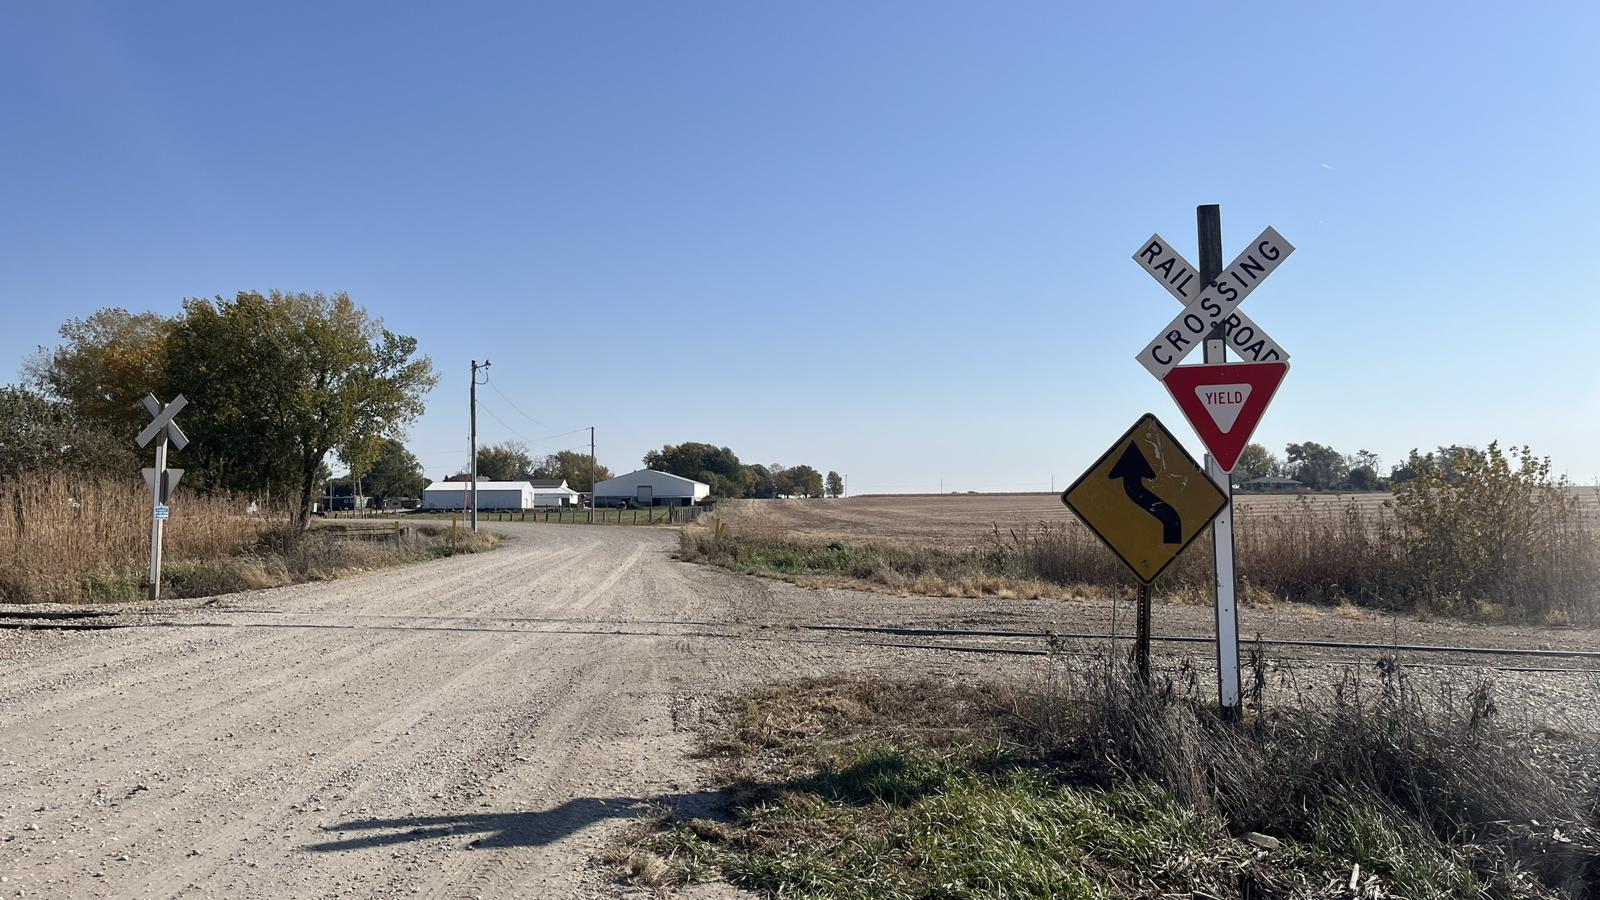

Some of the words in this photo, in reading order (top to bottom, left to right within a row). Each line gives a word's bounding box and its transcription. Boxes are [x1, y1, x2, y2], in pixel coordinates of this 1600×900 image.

[1140, 240, 1194, 297] RAIL
[1151, 240, 1280, 365] CROSSING
[1205, 391, 1243, 405] YIELD
